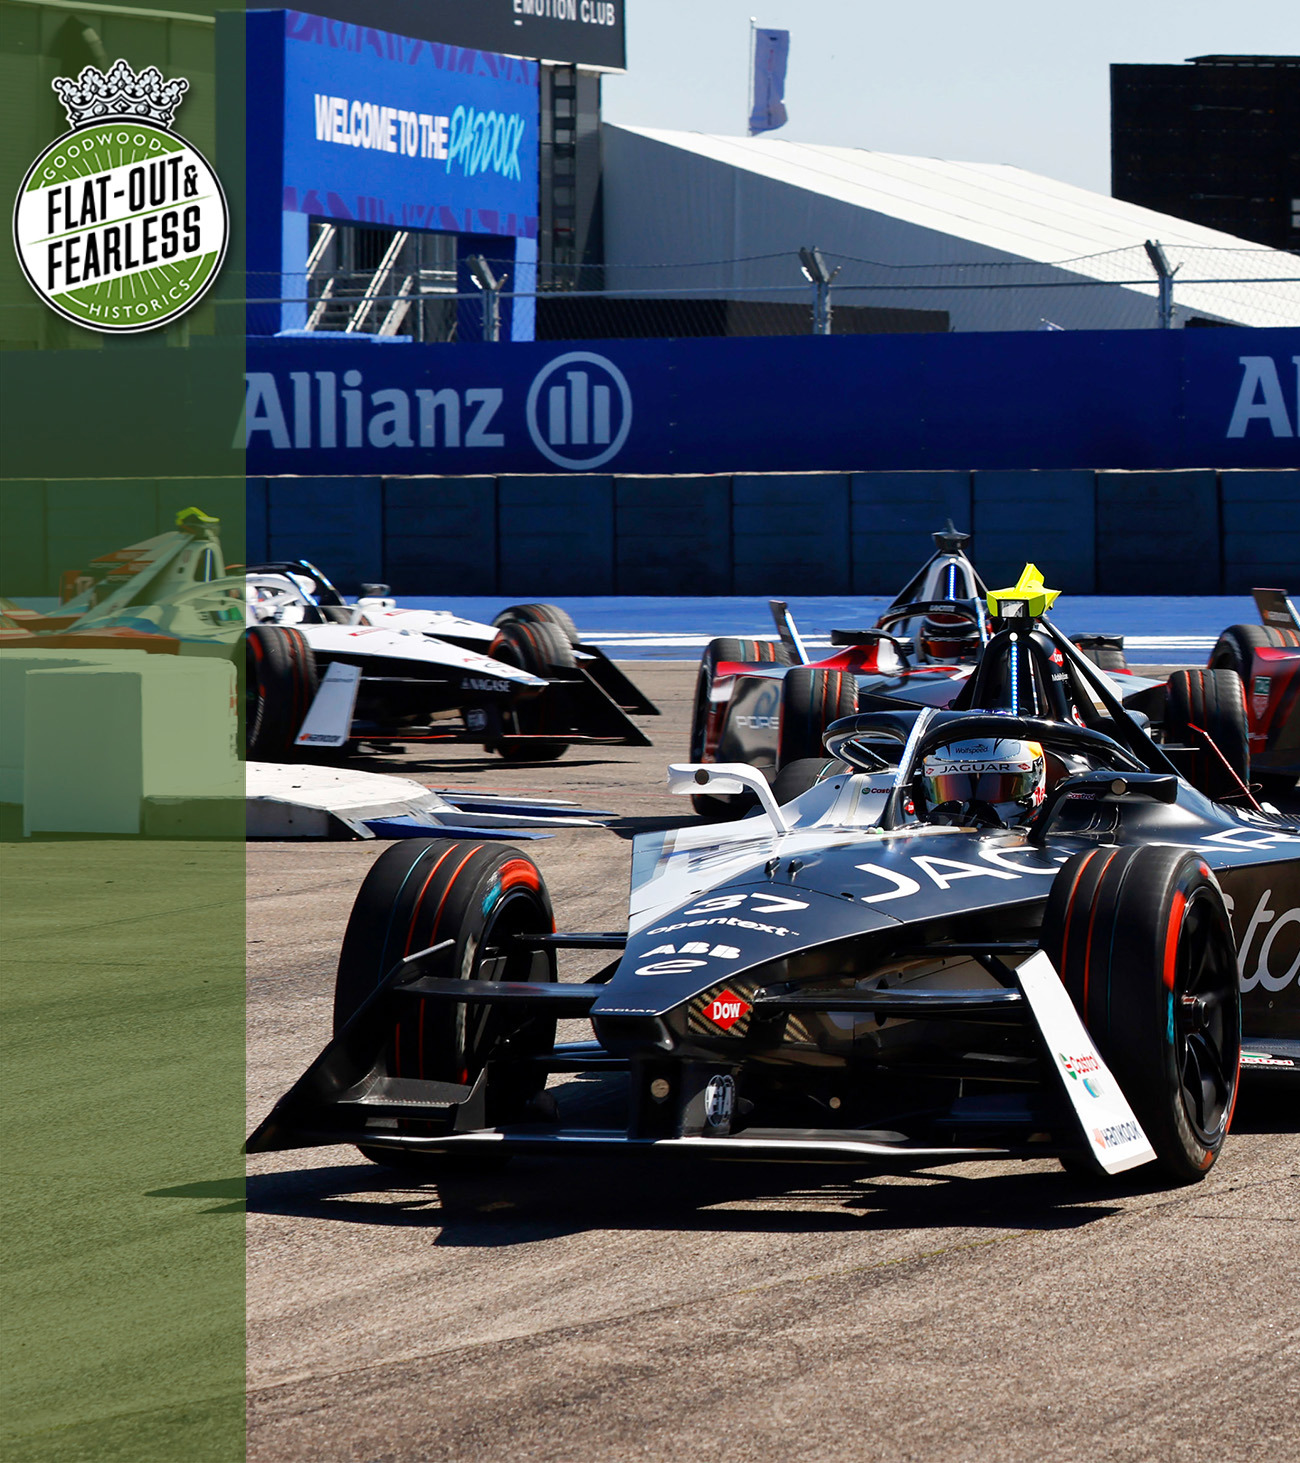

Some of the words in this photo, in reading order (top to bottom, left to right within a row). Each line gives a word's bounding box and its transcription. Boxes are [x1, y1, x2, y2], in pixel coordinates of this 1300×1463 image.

[580, 0, 616, 26] CLUB
[314, 93, 397, 153] WELCOME
[397, 109, 419, 157] TO
[419, 113, 449, 160] THE
[231, 369, 505, 449] Allianz
[735, 715, 779, 730] PORS
[939, 762, 1011, 774] JAGUAR
[683, 892, 810, 915] 37
[638, 941, 742, 959] ABB
